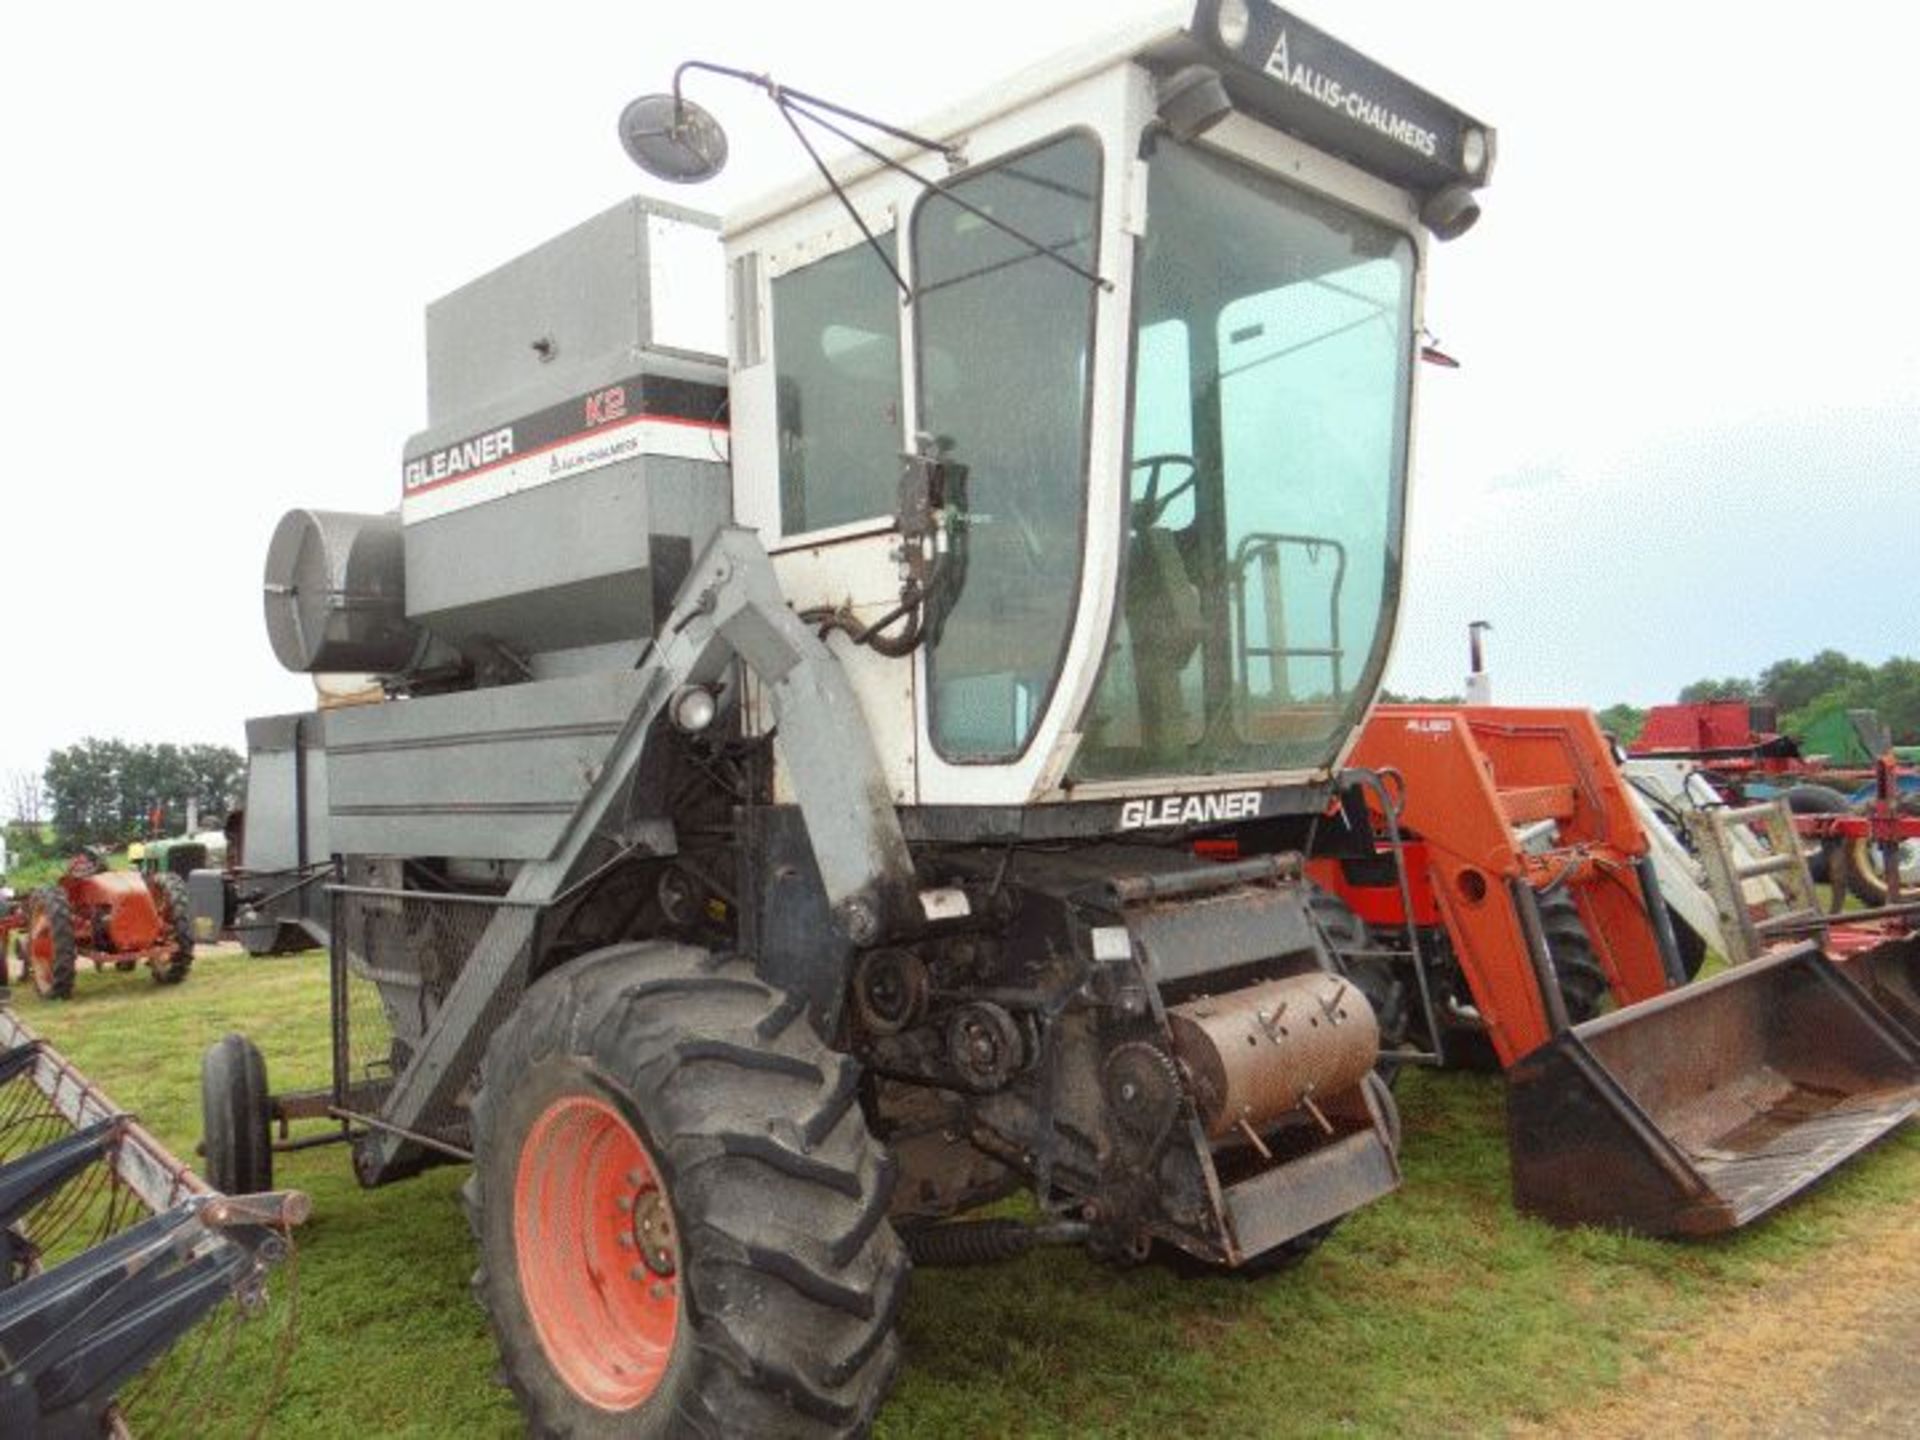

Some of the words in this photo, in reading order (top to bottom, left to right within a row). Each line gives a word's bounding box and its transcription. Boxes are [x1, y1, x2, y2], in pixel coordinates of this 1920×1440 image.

[1289, 63, 1438, 156] ALLIS-CHALMERS
[584, 387, 627, 426] K2
[404, 428, 513, 488] GLEANER
[1121, 791, 1262, 828] GLEANER
